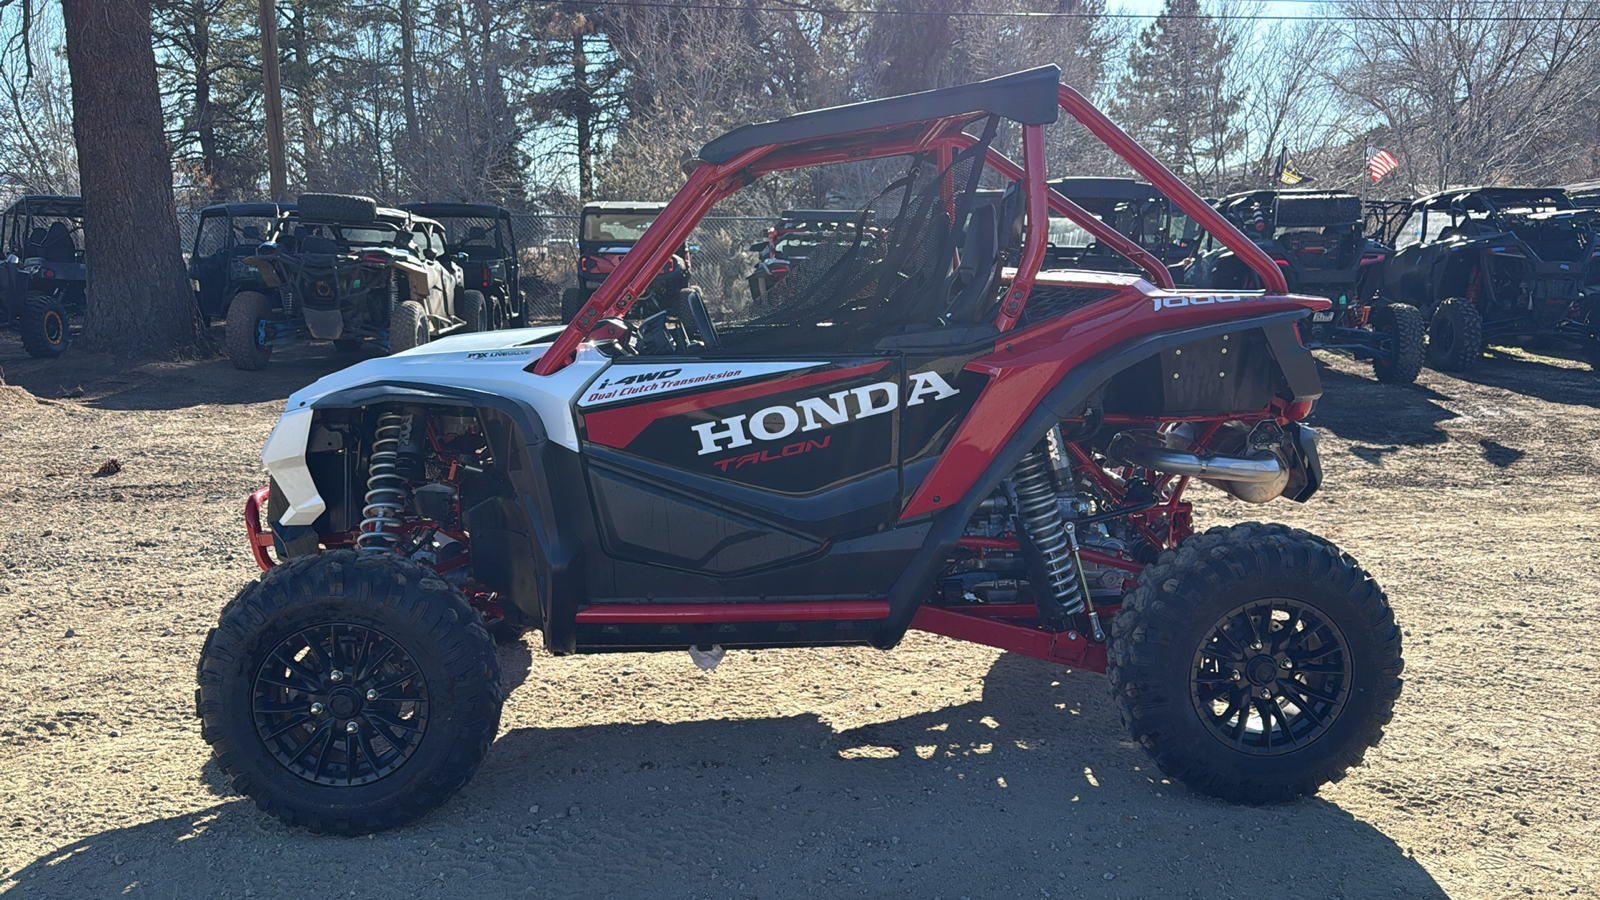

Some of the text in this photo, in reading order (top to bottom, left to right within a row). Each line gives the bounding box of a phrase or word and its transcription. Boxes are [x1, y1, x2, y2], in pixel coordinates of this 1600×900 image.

[588, 370, 742, 402] Dual Clutch Transmission
[598, 368, 683, 390] i-4WD
[691, 370, 960, 456] HONDA
[713, 435, 831, 473] TALON
